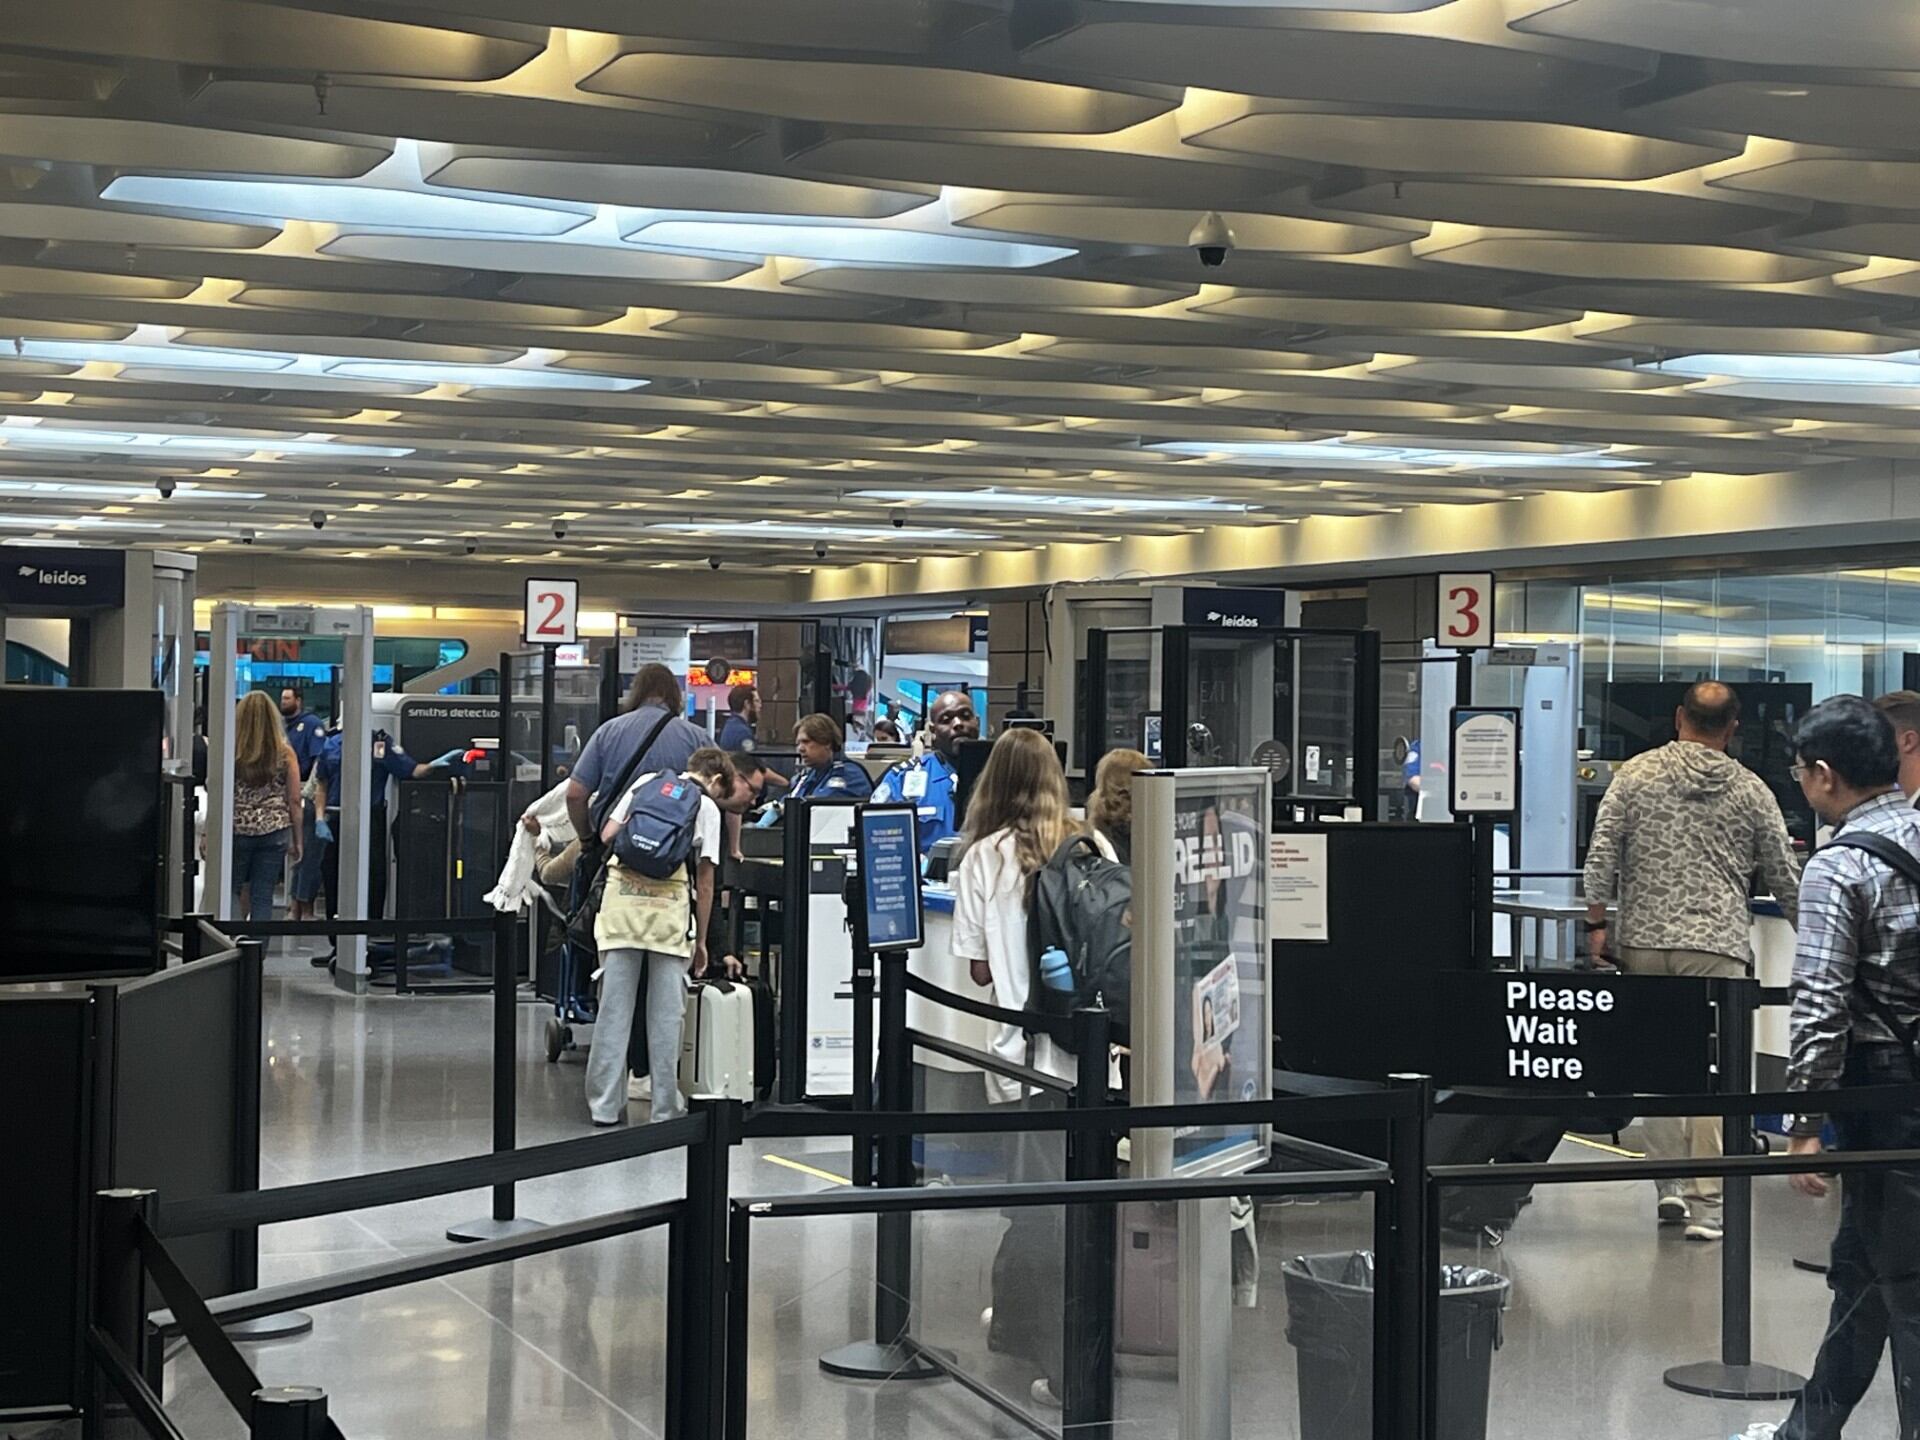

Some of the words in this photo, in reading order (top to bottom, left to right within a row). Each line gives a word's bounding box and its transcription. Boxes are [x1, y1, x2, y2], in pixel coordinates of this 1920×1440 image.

[39, 569, 87, 585] leidos
[535, 592, 565, 635] 2
[1221, 614, 1259, 627] leidos
[1448, 587, 1480, 637] 3
[408, 708, 448, 718] smiths
[450, 708, 500, 718] detectio
[1231, 831, 1255, 878] ID
[1506, 981, 1615, 1012] Please
[1505, 1015, 1578, 1045] Wait
[1508, 1048, 1583, 1080] Here
